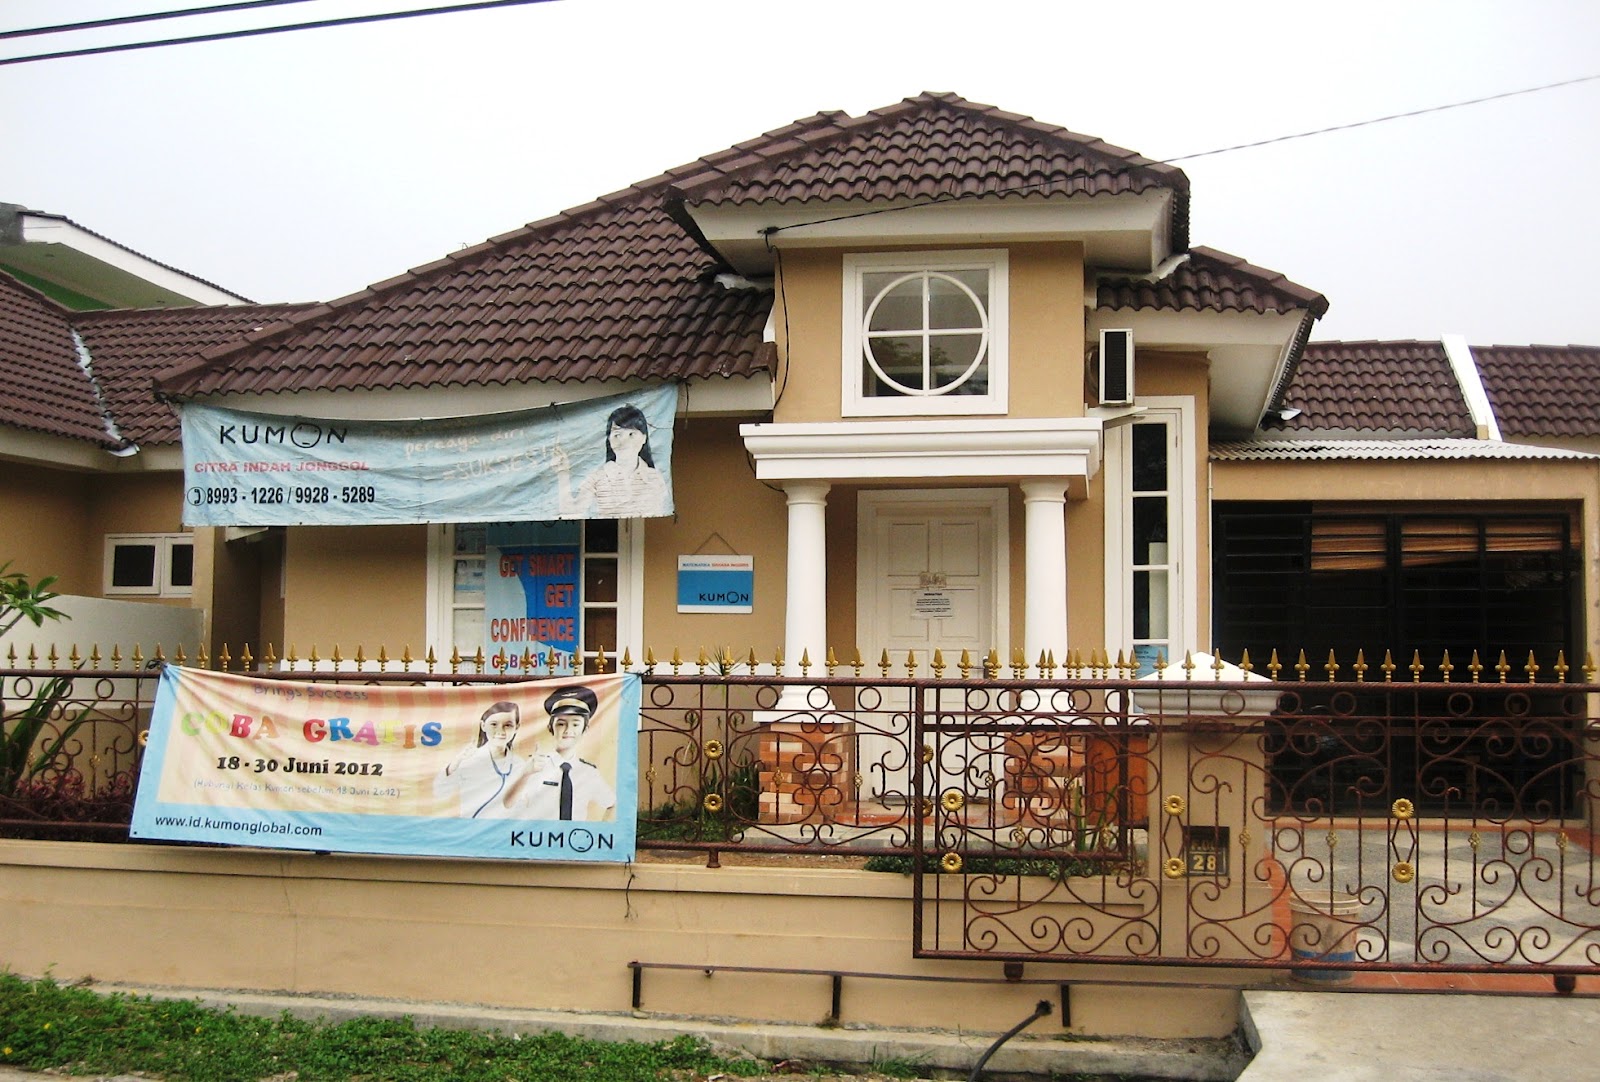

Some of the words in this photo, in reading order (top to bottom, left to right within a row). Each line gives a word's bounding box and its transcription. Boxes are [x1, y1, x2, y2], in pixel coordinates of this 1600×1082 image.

[220, 423, 348, 448] KUMON
[404, 435, 480, 460] percaya
[194, 461, 238, 473] CITRA
[243, 462, 291, 473] INDAH
[296, 461, 370, 473] JONGGOL
[206, 487, 238, 504] 8993
[251, 487, 283, 504] 1226
[295, 486, 329, 504] 9928
[342, 486, 375, 503] 5289
[499, 554, 524, 577] GET
[529, 553, 575, 577] SMART
[545, 583, 575, 607] GET
[699, 591, 749, 604] KUMON
[490, 617, 575, 642] CONFIDENCE
[254, 683, 302, 700] Brings
[307, 686, 369, 700] Success
[181, 711, 280, 740] COBA
[303, 717, 442, 749] GRATIS
[216, 756, 240, 770] 18
[254, 758, 279, 773] 30
[283, 757, 329, 775] Juni
[335, 761, 384, 777] 2012
[337, 785, 348, 796] 18
[350, 786, 370, 797] Juni
[155, 815, 323, 837] www.id.kumonglobal.com
[511, 828, 613, 853] KUMON
[1192, 854, 1217, 871] 28
